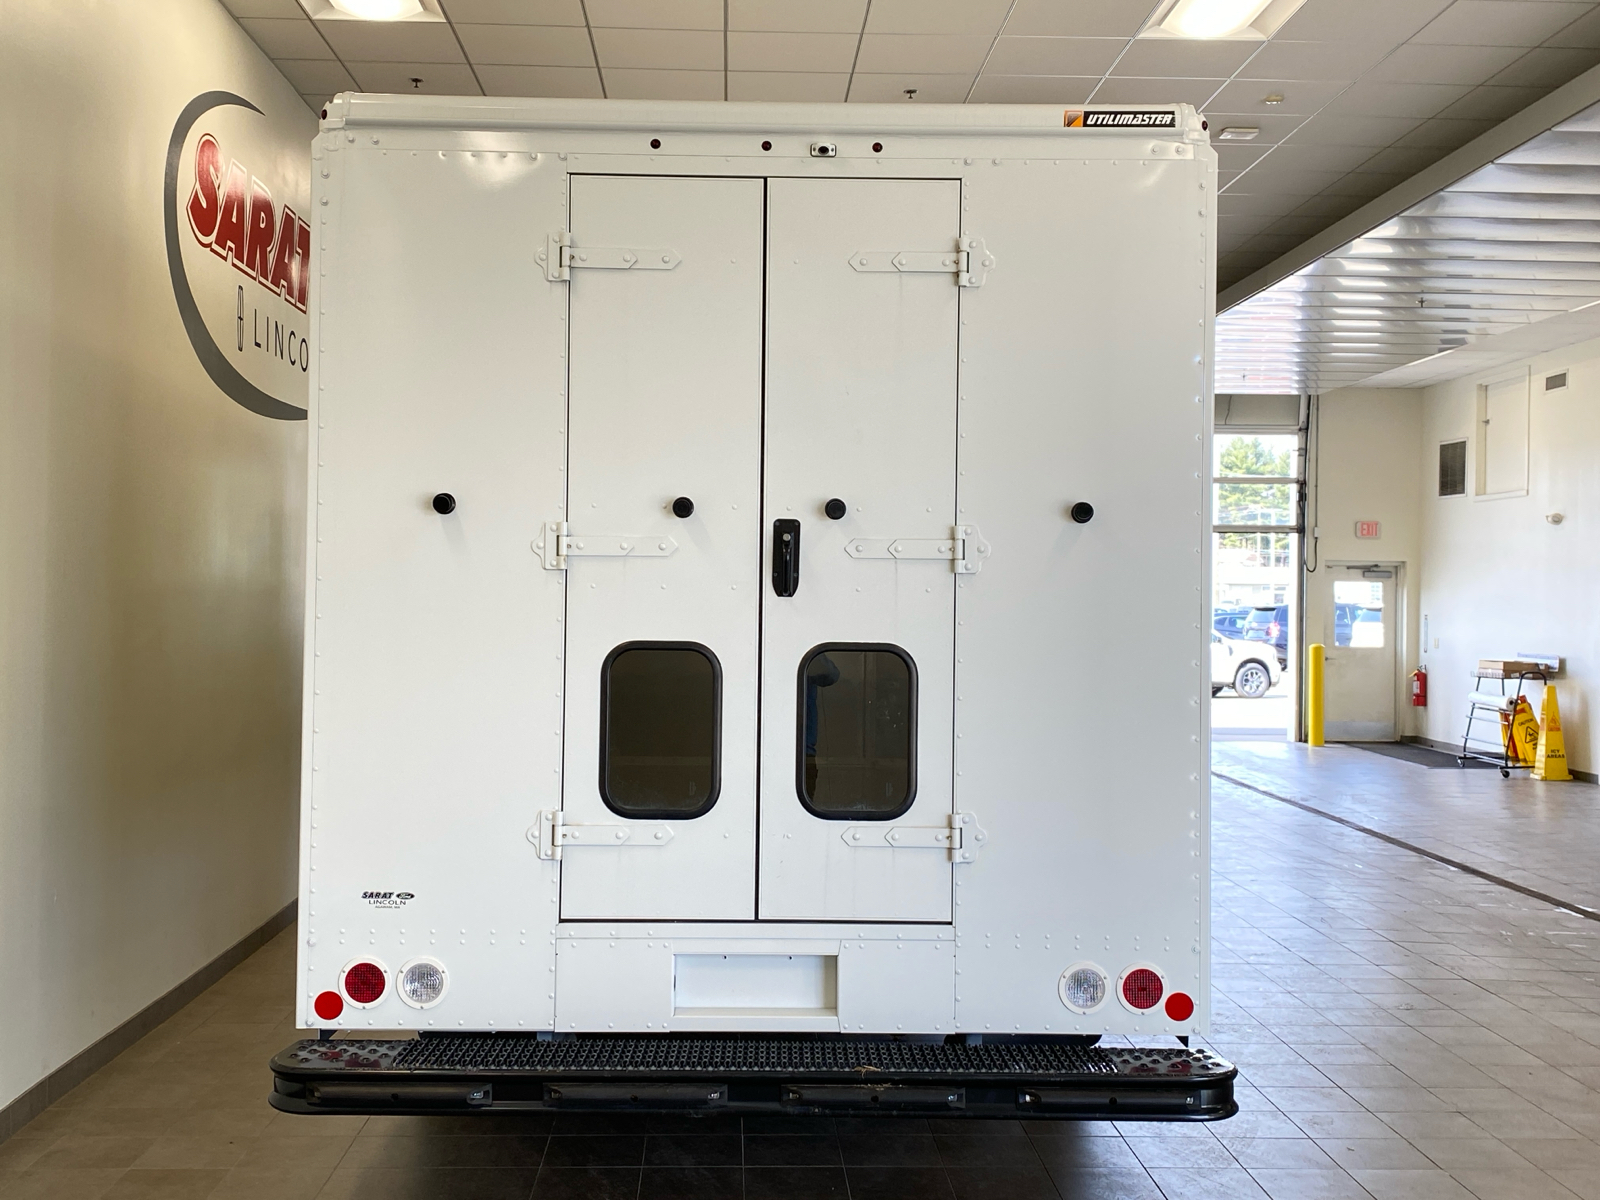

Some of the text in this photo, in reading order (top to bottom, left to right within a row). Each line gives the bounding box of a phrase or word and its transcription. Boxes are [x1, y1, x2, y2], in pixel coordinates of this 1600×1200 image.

[1086, 113, 1174, 125] UTILIMASTER
[1360, 521, 1378, 536] EXIT
[361, 891, 394, 899] SARAT
